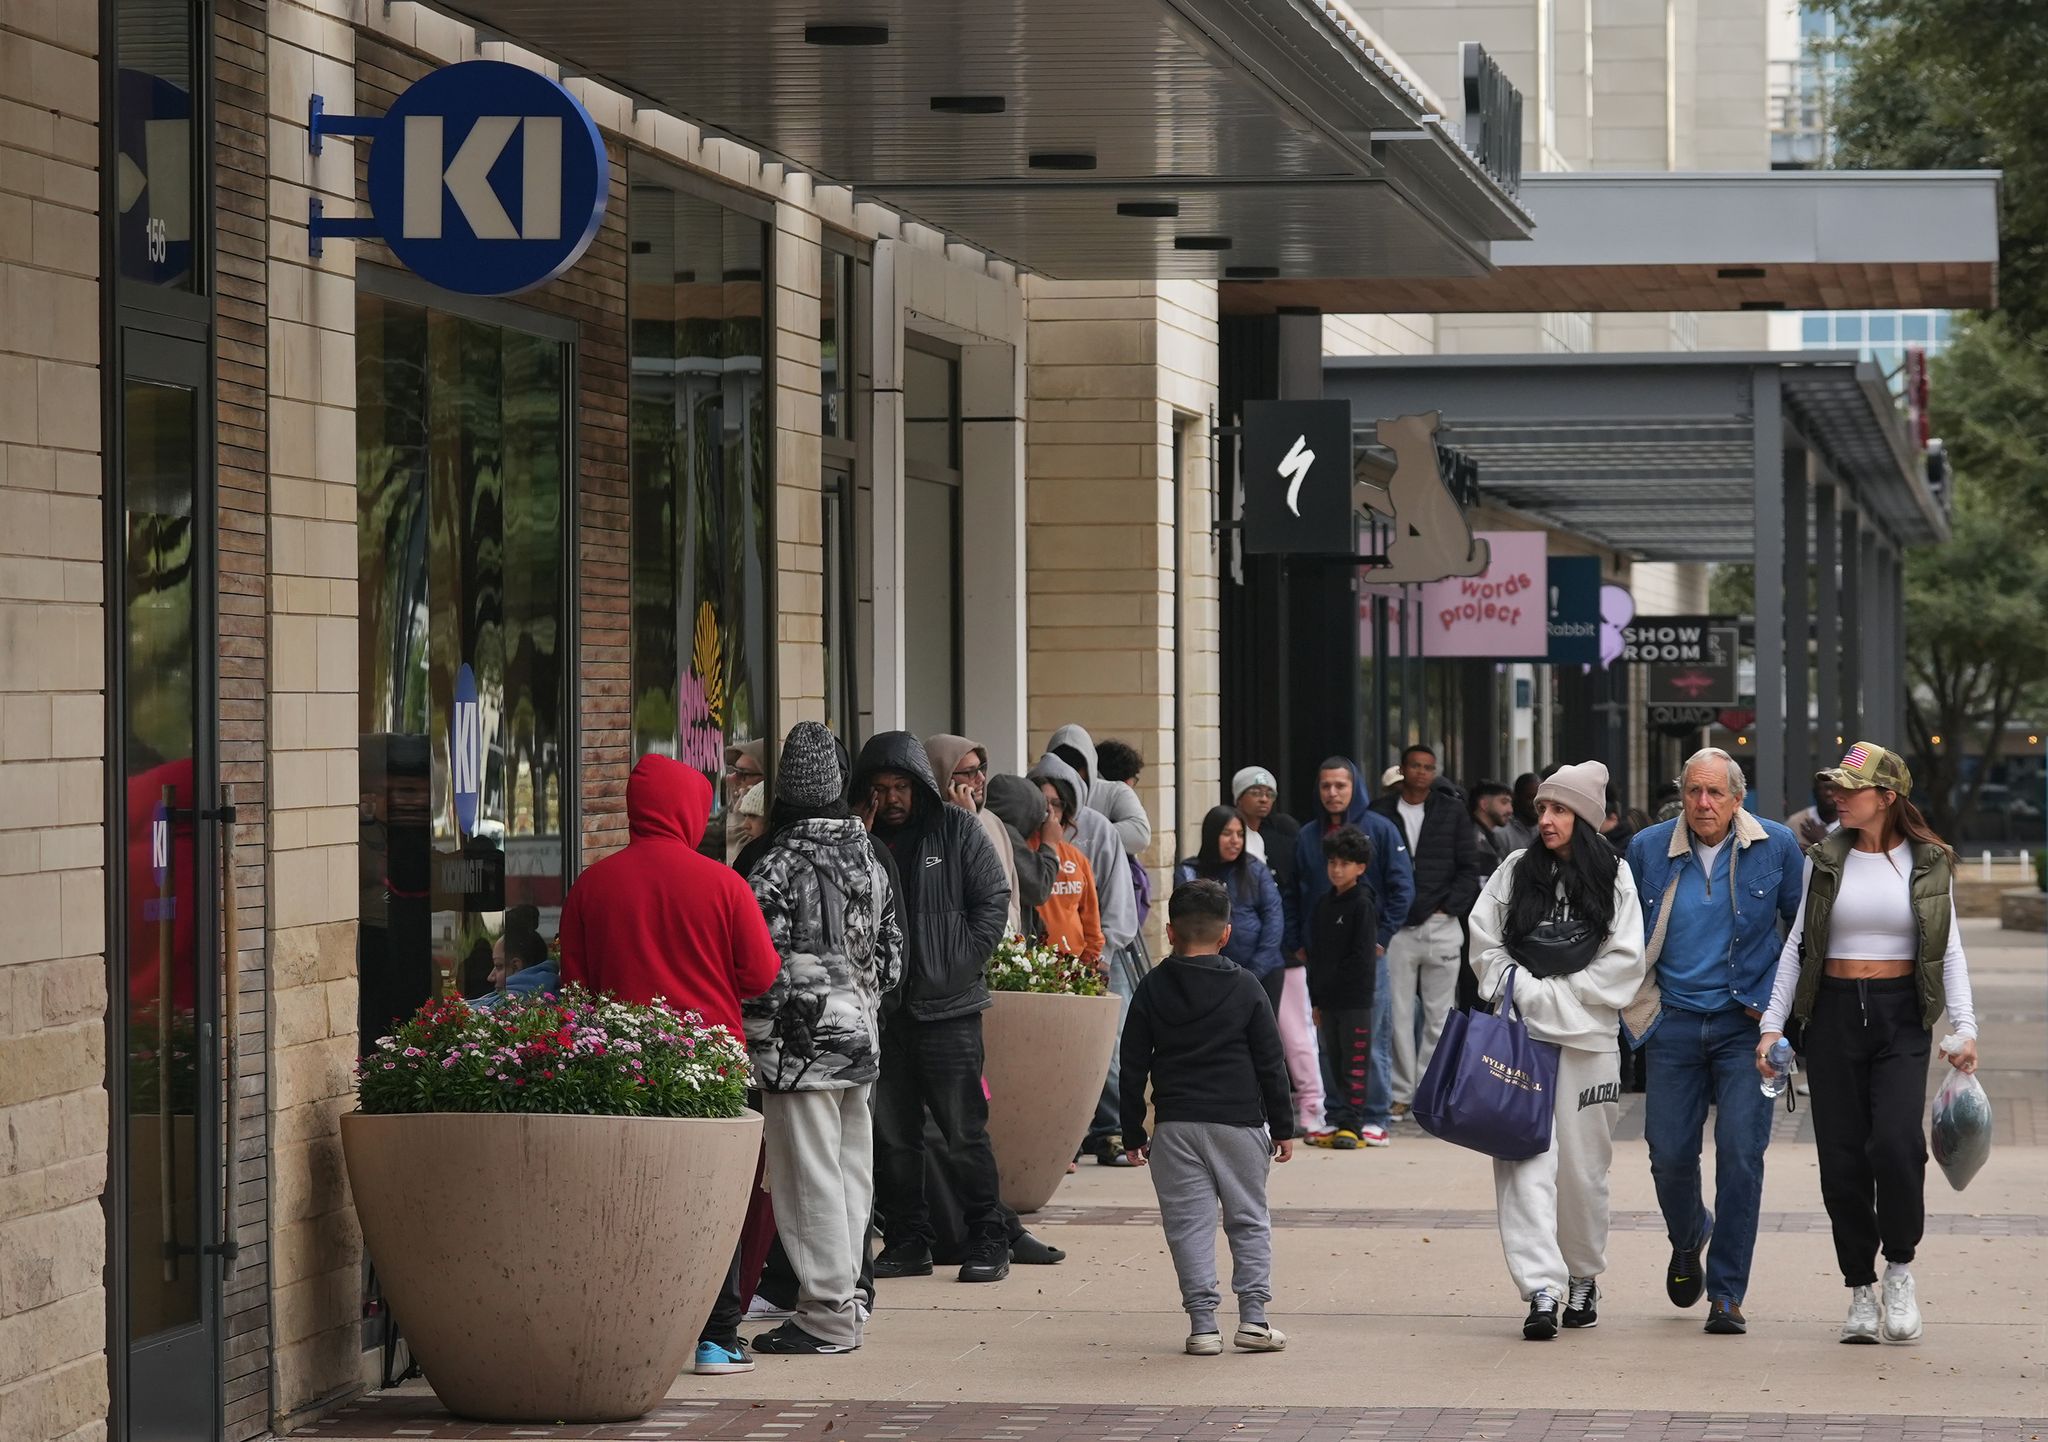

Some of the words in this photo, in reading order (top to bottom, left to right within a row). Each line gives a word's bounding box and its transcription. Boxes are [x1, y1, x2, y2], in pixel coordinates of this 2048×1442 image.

[403, 115, 562, 240] KI
[146, 217, 166, 264] 156
[1460, 572, 1532, 599] words
[1440, 598, 1521, 631] project
[1622, 626, 1701, 643] SHOW
[1622, 644, 1701, 661] ROOM
[455, 702, 477, 793] KI
[153, 820, 167, 867] KI
[1481, 1054, 1506, 1072] NYLE
